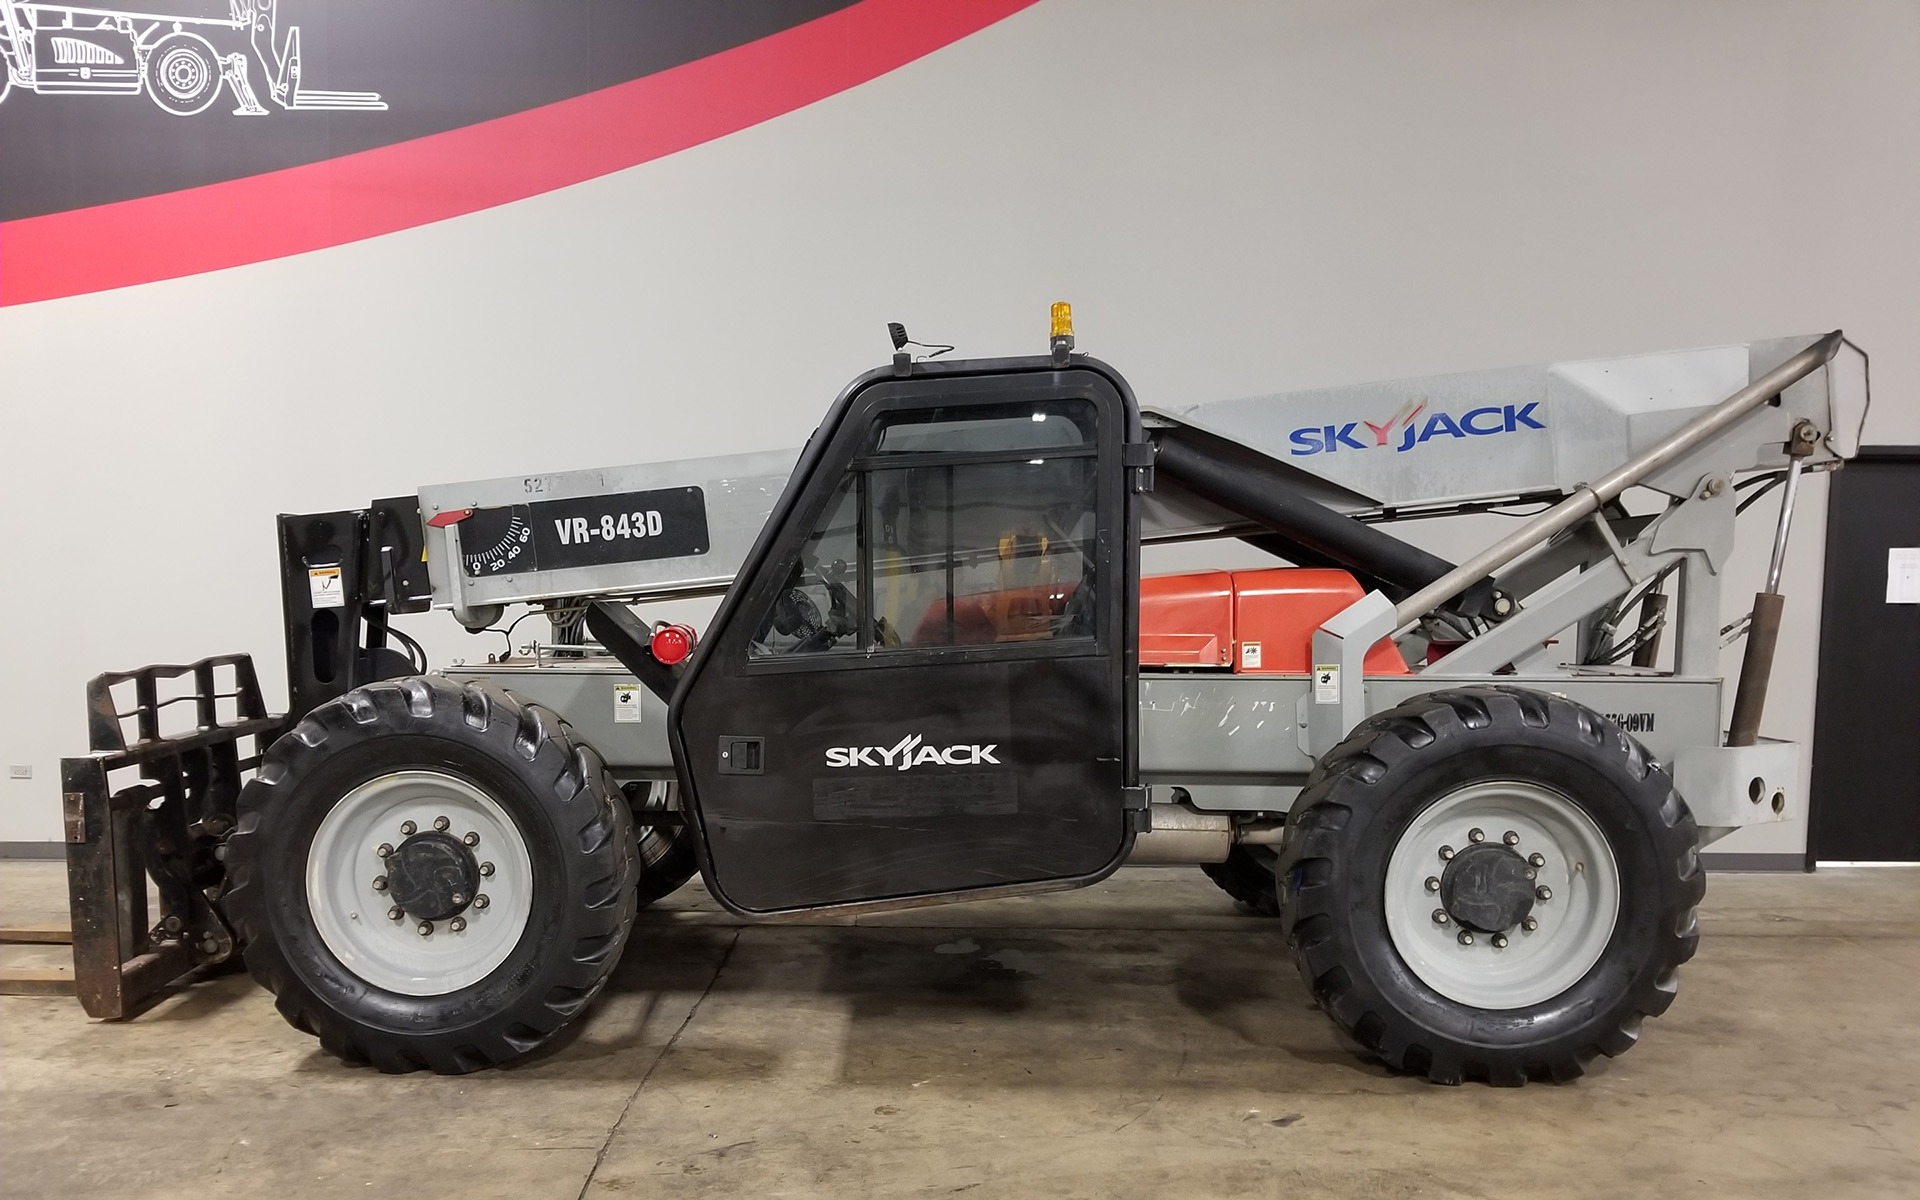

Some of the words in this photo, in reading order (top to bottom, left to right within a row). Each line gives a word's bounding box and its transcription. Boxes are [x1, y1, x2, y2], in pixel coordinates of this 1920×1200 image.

[1289, 398, 1547, 455] SKYJACK
[554, 511, 663, 545] VR-843D
[472, 562, 481, 571] 0
[489, 559, 506, 572] 20
[507, 545, 521, 560] 40
[519, 527, 531, 543] 60
[825, 733, 1002, 771] SKYJACK
